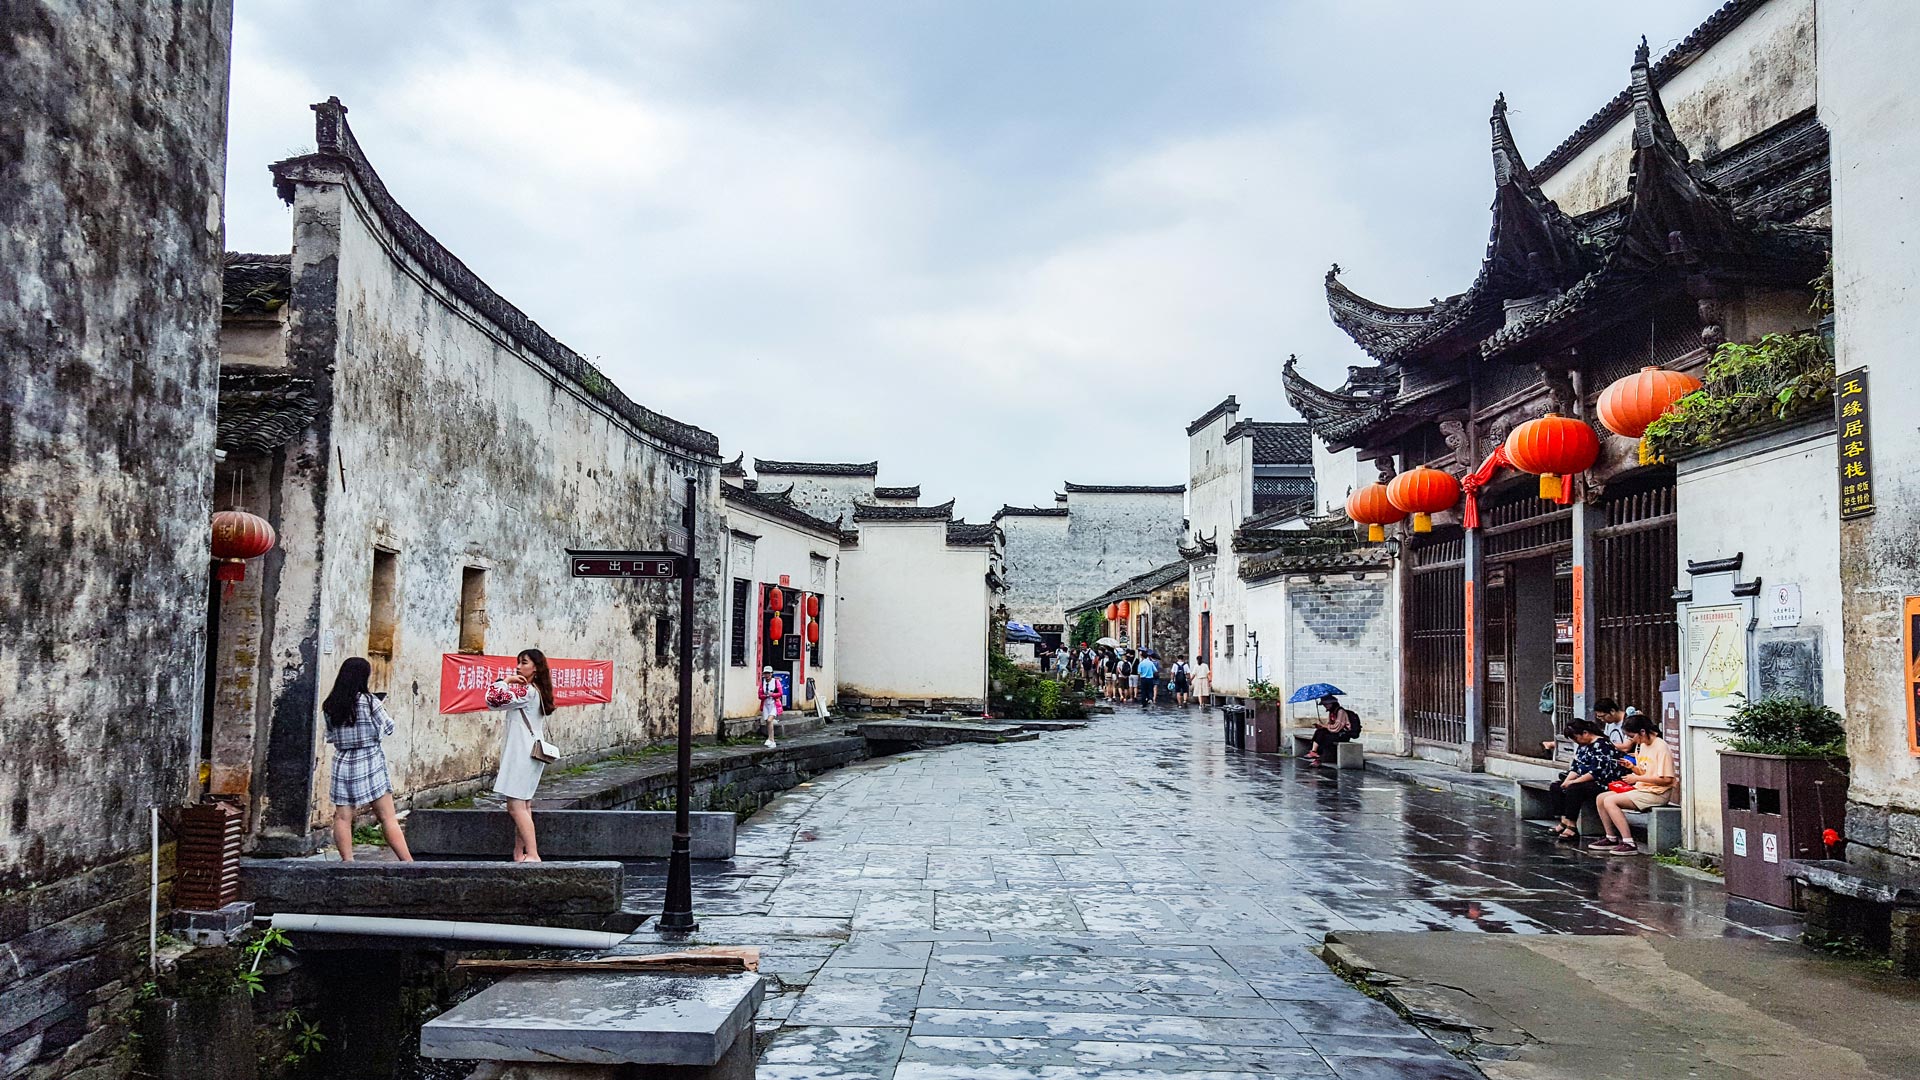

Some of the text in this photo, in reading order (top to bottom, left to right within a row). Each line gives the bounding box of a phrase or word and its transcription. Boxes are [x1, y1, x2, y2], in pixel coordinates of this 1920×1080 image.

[1842, 379, 1867, 479] 玉缘居客栈
[1844, 481, 1869, 495] 住宿 吃饭
[1844, 493, 1870, 506] 学生特价
[609, 560, 644, 571] 出口
[457, 665, 493, 690] 发动群众
